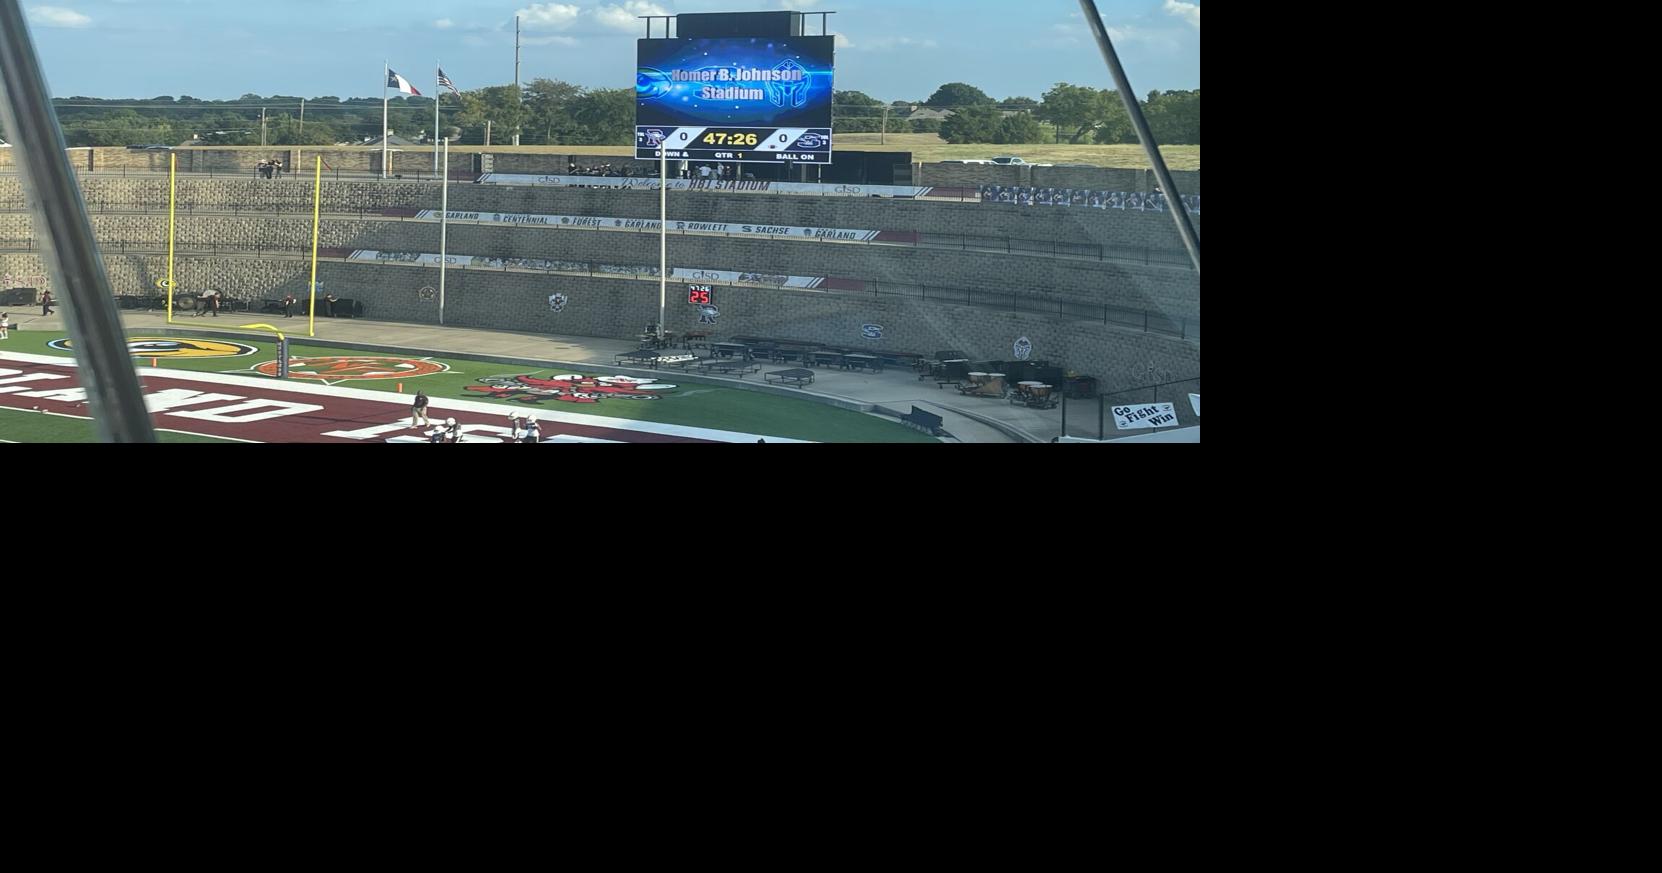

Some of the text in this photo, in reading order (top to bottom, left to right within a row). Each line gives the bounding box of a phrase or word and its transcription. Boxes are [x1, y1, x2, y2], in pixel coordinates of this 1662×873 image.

[672, 68, 802, 81] Homer B. Johnson
[702, 86, 763, 100] Stadium
[680, 132, 688, 141] 0
[703, 132, 757, 145] 47:26
[779, 134, 788, 143] 0
[714, 180, 771, 191] STADIUM
[446, 211, 479, 220] GARLAND
[503, 215, 548, 225] CENTENNIAL
[572, 217, 601, 227] FOREST
[624, 219, 662, 230] GARLAND
[688, 222, 728, 231] ROWLETT
[755, 226, 791, 235] SACHSE
[815, 229, 857, 240] GARLAND
[690, 291, 709, 303] 25
[1114, 406, 1131, 417] Go
[1124, 405, 1160, 424] Fight
[1147, 412, 1174, 427] Win
